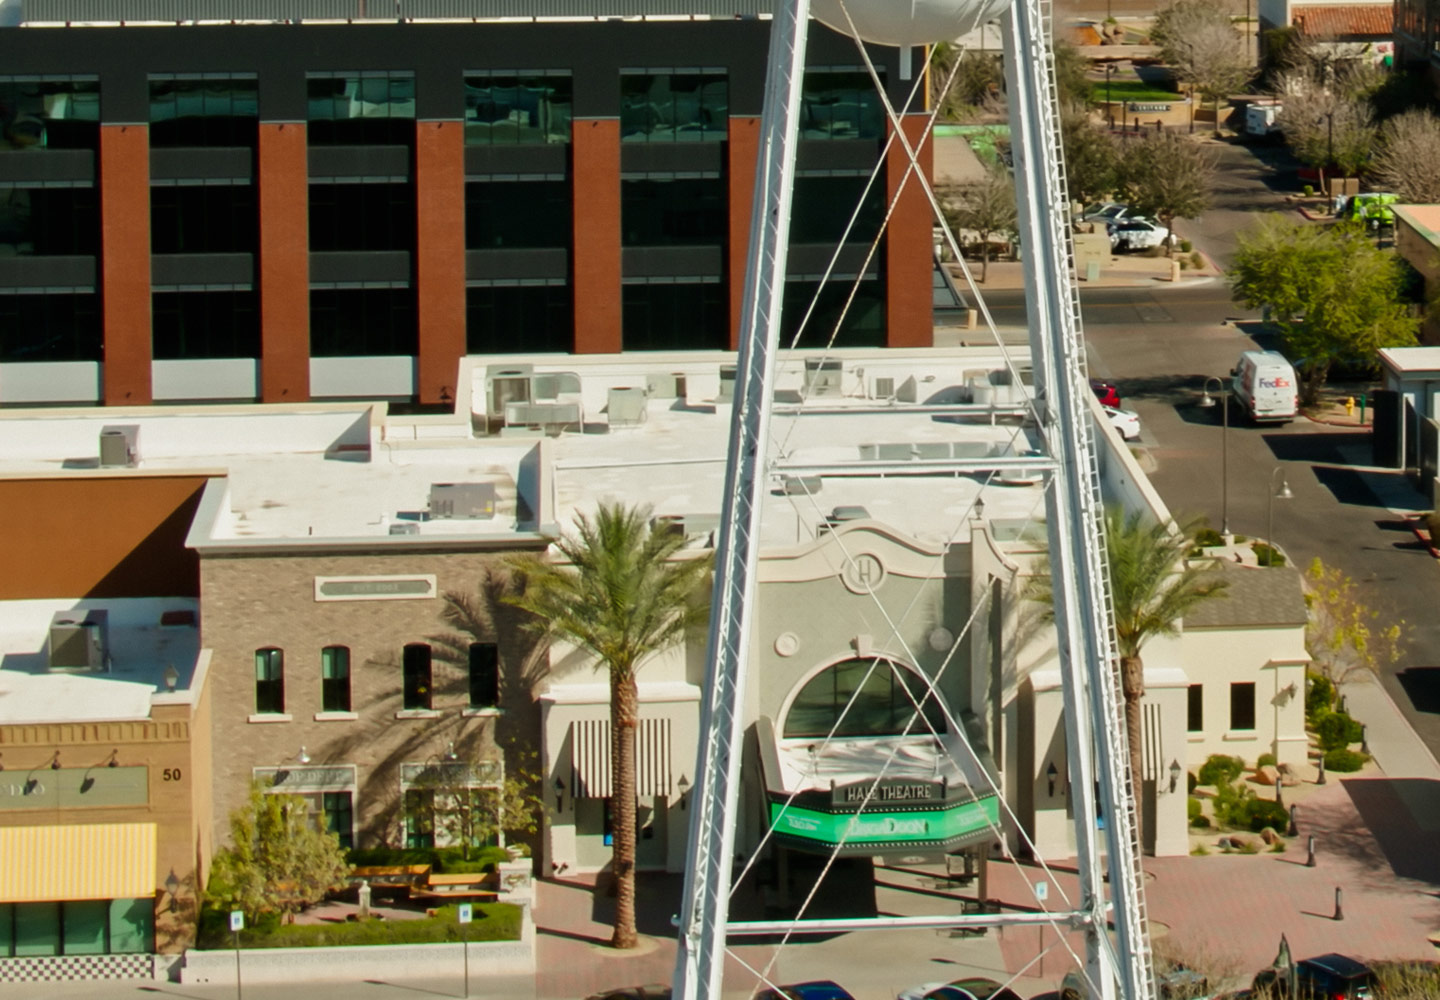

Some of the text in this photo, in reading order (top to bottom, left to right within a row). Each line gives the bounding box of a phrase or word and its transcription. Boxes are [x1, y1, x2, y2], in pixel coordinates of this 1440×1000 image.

[1259, 377, 1290, 388] FedEx
[163, 768, 181, 781] 50
[882, 785, 931, 800] THEATRE
